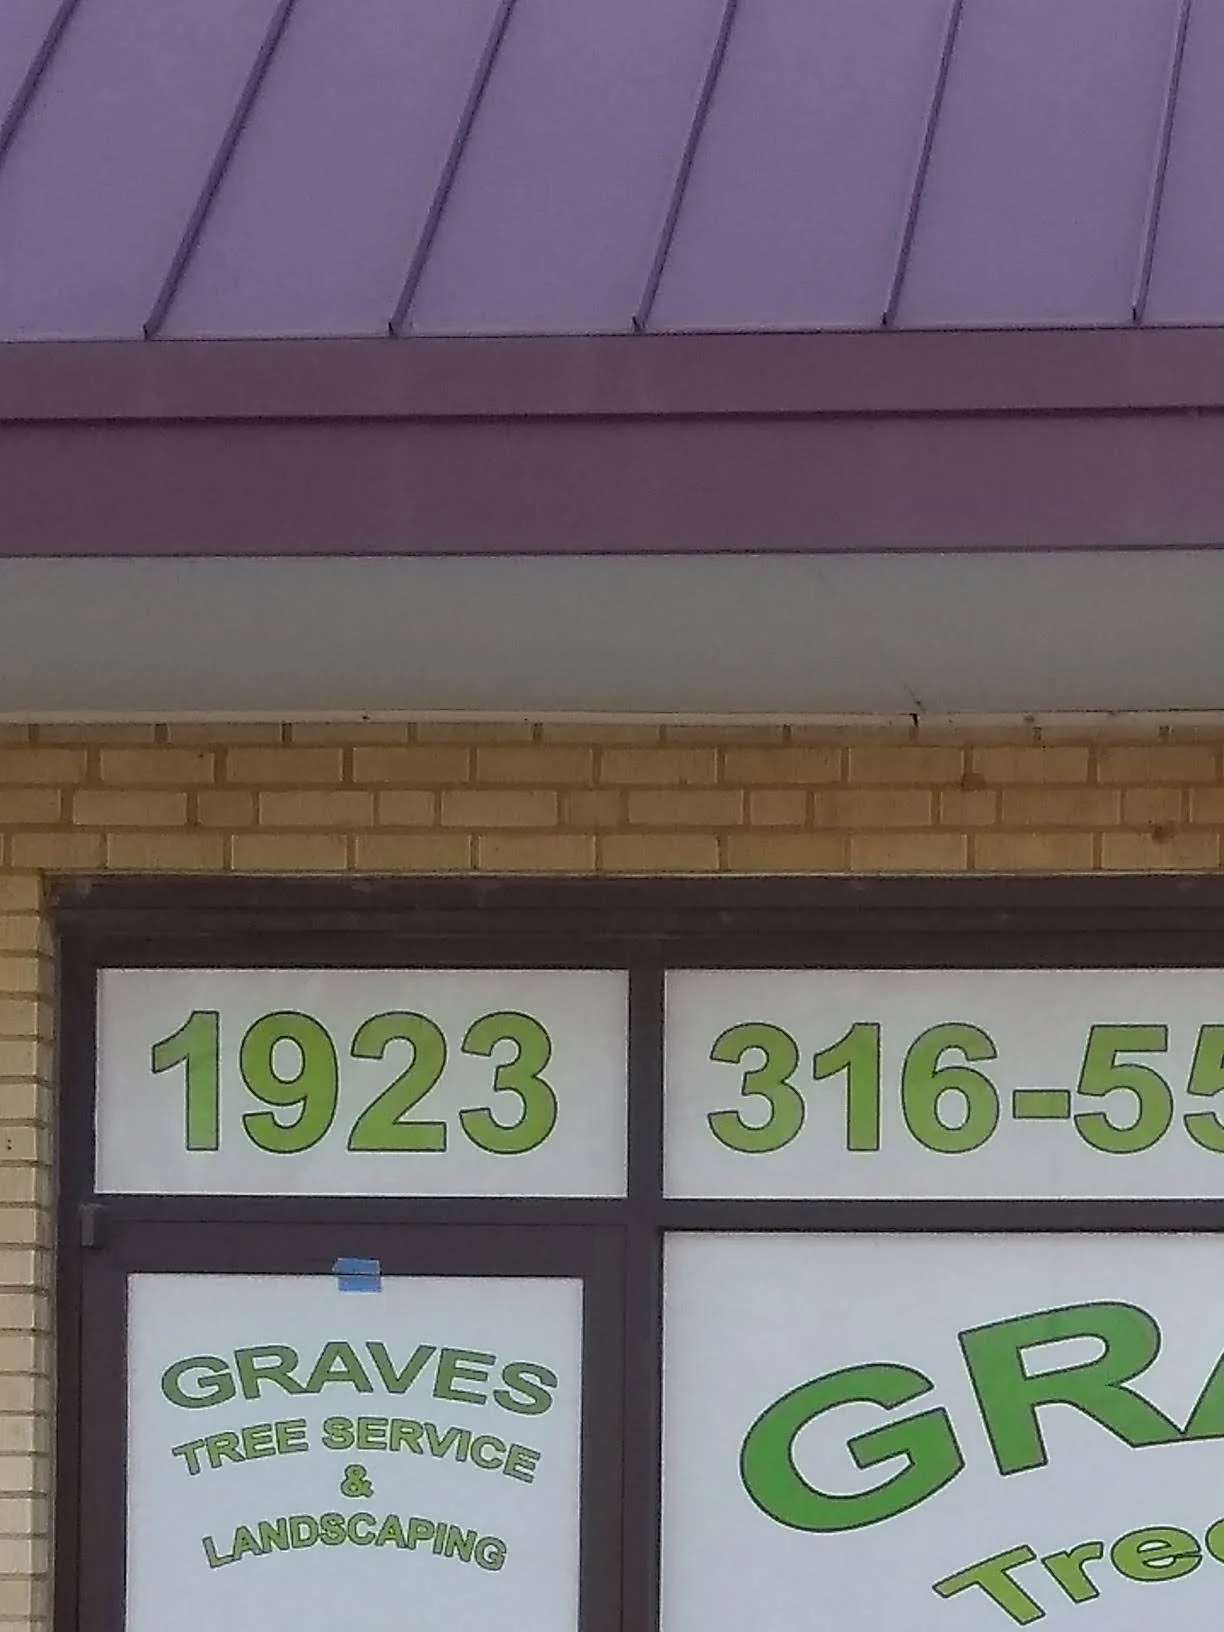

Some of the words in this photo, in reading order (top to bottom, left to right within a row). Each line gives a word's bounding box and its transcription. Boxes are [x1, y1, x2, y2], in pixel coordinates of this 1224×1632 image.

[151, 1010, 559, 1154] 1923
[160, 1341, 560, 1416] GRAVES
[172, 1417, 309, 1476] TREE
[322, 1416, 541, 1484] SERVICE
[340, 1463, 375, 1499] &
[202, 1512, 508, 1572] LANDSCAPING
